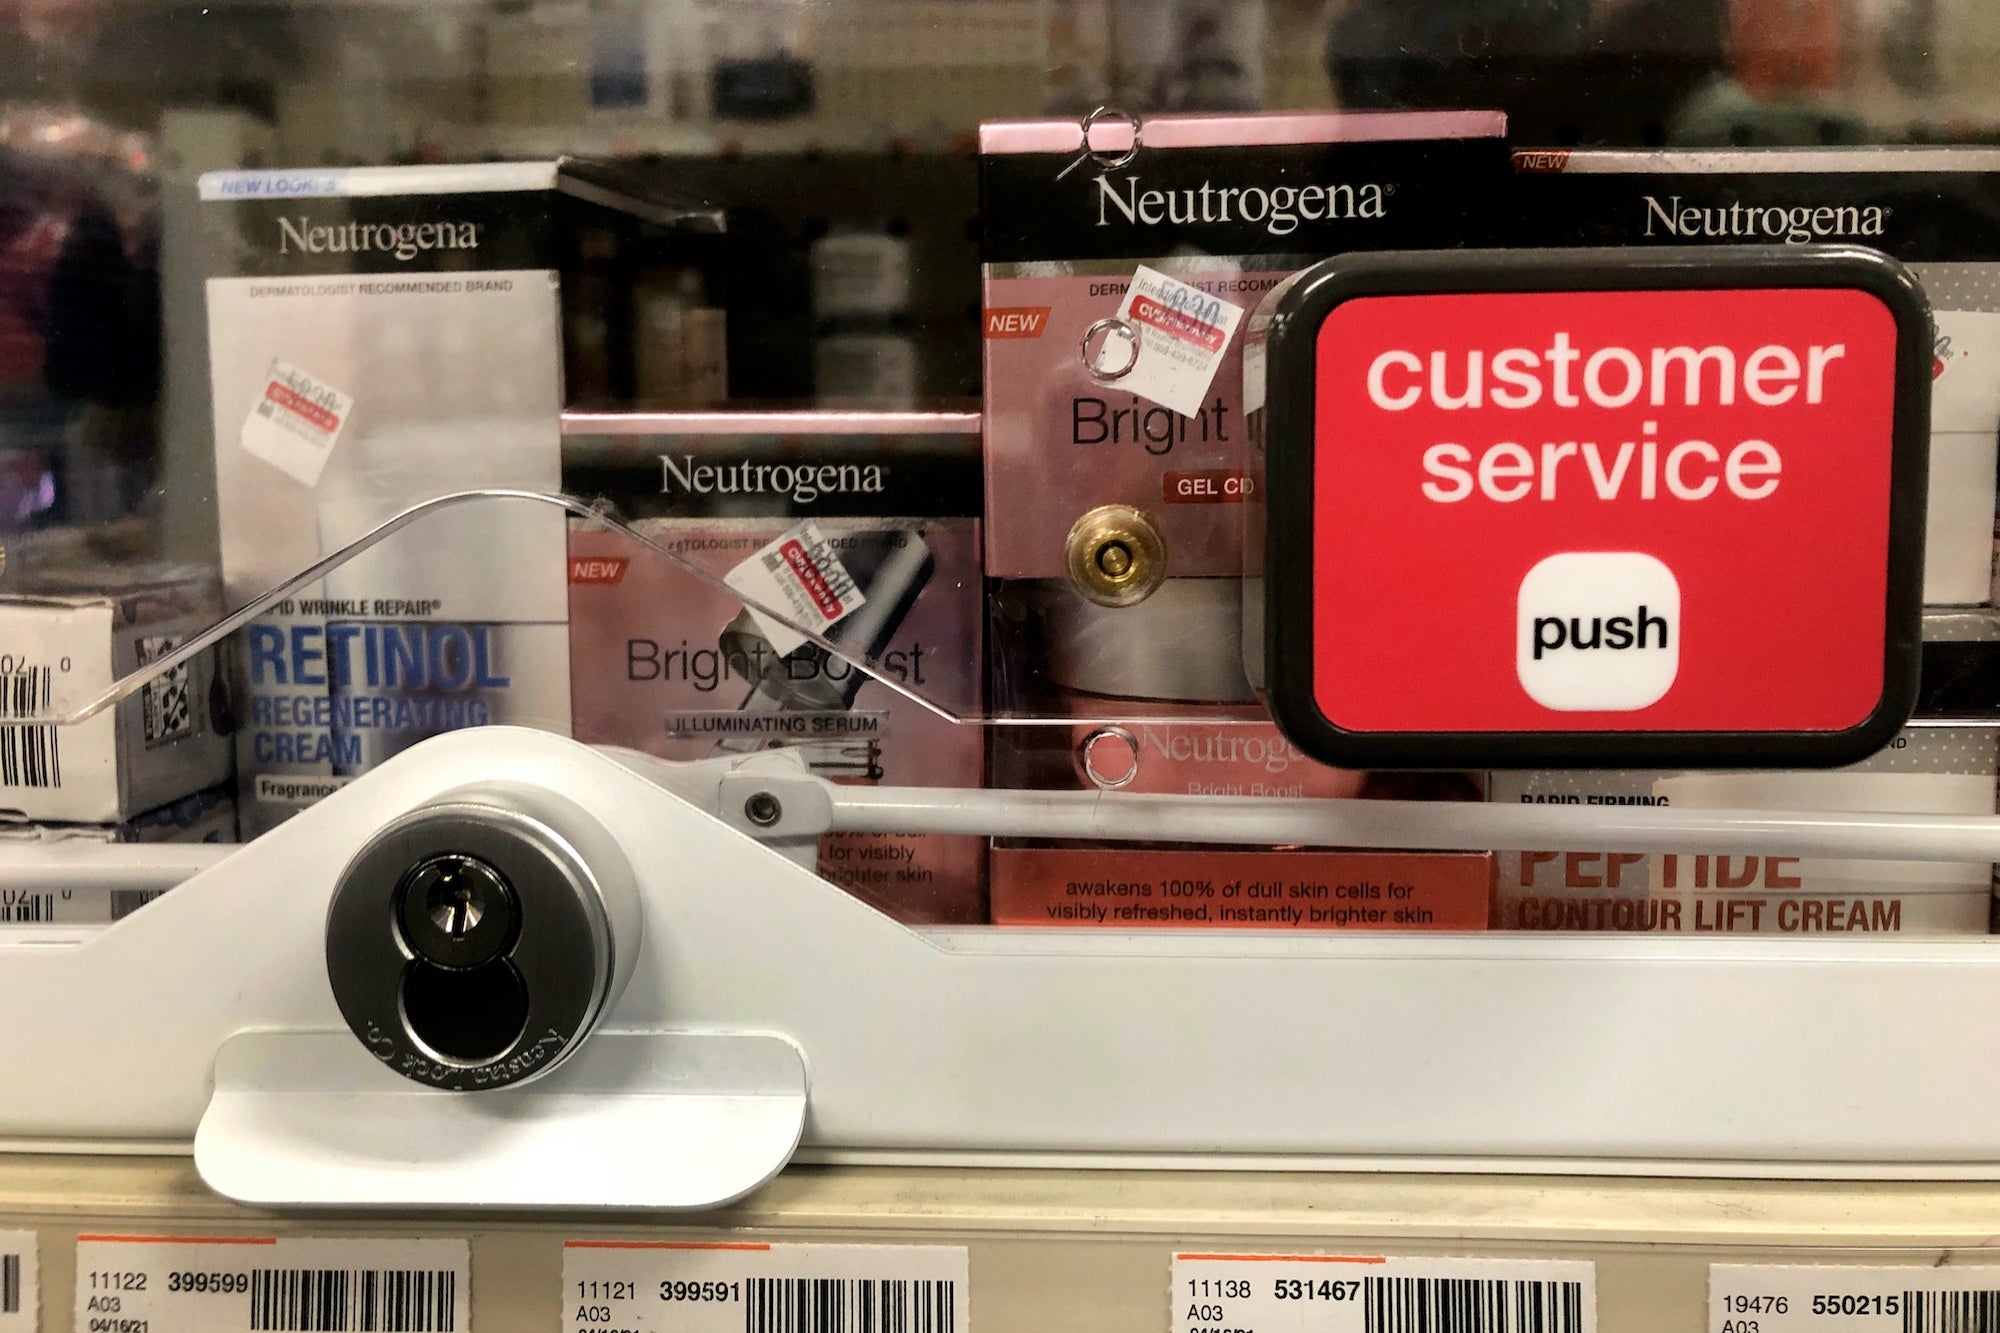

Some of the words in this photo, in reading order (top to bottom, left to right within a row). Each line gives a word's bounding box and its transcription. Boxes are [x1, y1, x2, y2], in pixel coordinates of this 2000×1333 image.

[1523, 155, 1564, 169] NEW
[220, 178, 262, 194] NEW
[277, 216, 479, 260] Neutrogena
[250, 285, 355, 298] DERMATOLOGIST
[359, 282, 462, 295] RECOMMENDED
[466, 281, 513, 292] BRAND
[989, 314, 1041, 331] NEW
[1367, 332, 1845, 411] customer
[1421, 421, 1782, 503] service
[1177, 478, 1218, 495] GEL
[574, 562, 620, 578] NEW
[300, 599, 370, 616] WRINKLE
[1533, 605, 1668, 660] push
[251, 625, 510, 688] RETINOL
[626, 639, 768, 693] Bright
[253, 696, 489, 728] REGENERATING
[676, 717, 807, 733] ILLUMINATING
[811, 717, 878, 733] SERUM
[254, 732, 362, 765] CREAM
[829, 844, 853, 860] for
[859, 844, 915, 864] visibly
[896, 866, 933, 883] skin
[1066, 881, 1152, 898] awakens
[1160, 881, 1215, 898] 100%
[1222, 881, 1244, 898] of
[1247, 881, 1283, 899] dull
[1289, 882, 1329, 899] skin
[1335, 882, 1383, 899] cells
[1388, 883, 1414, 900] for
[1047, 903, 1105, 923] visibly
[1220, 905, 1302, 926] instantly
[1310, 905, 1387, 926] brighter
[1394, 906, 1434, 924] skin
[1518, 899, 1682, 932] CONTOUR
[1695, 900, 1767, 932] LIFT
[1778, 900, 1901, 932] CREAM
[90, 1271, 147, 1290] 11122
[168, 1272, 249, 1293] 399599
[577, 1281, 636, 1299] 11121
[659, 1281, 740, 1301] 399591
[1187, 1280, 1251, 1298] 11138
[1274, 1280, 1360, 1301] 531467
[87, 1296, 121, 1313] A03
[576, 1305, 611, 1322] A03
[1187, 1304, 1223, 1321] A03
[1723, 1295, 1788, 1314] 19476
[1812, 1295, 1899, 1315] 550215
[89, 1318, 149, 1333] 04/16/21
[1721, 1320, 1760, 1333] A03
